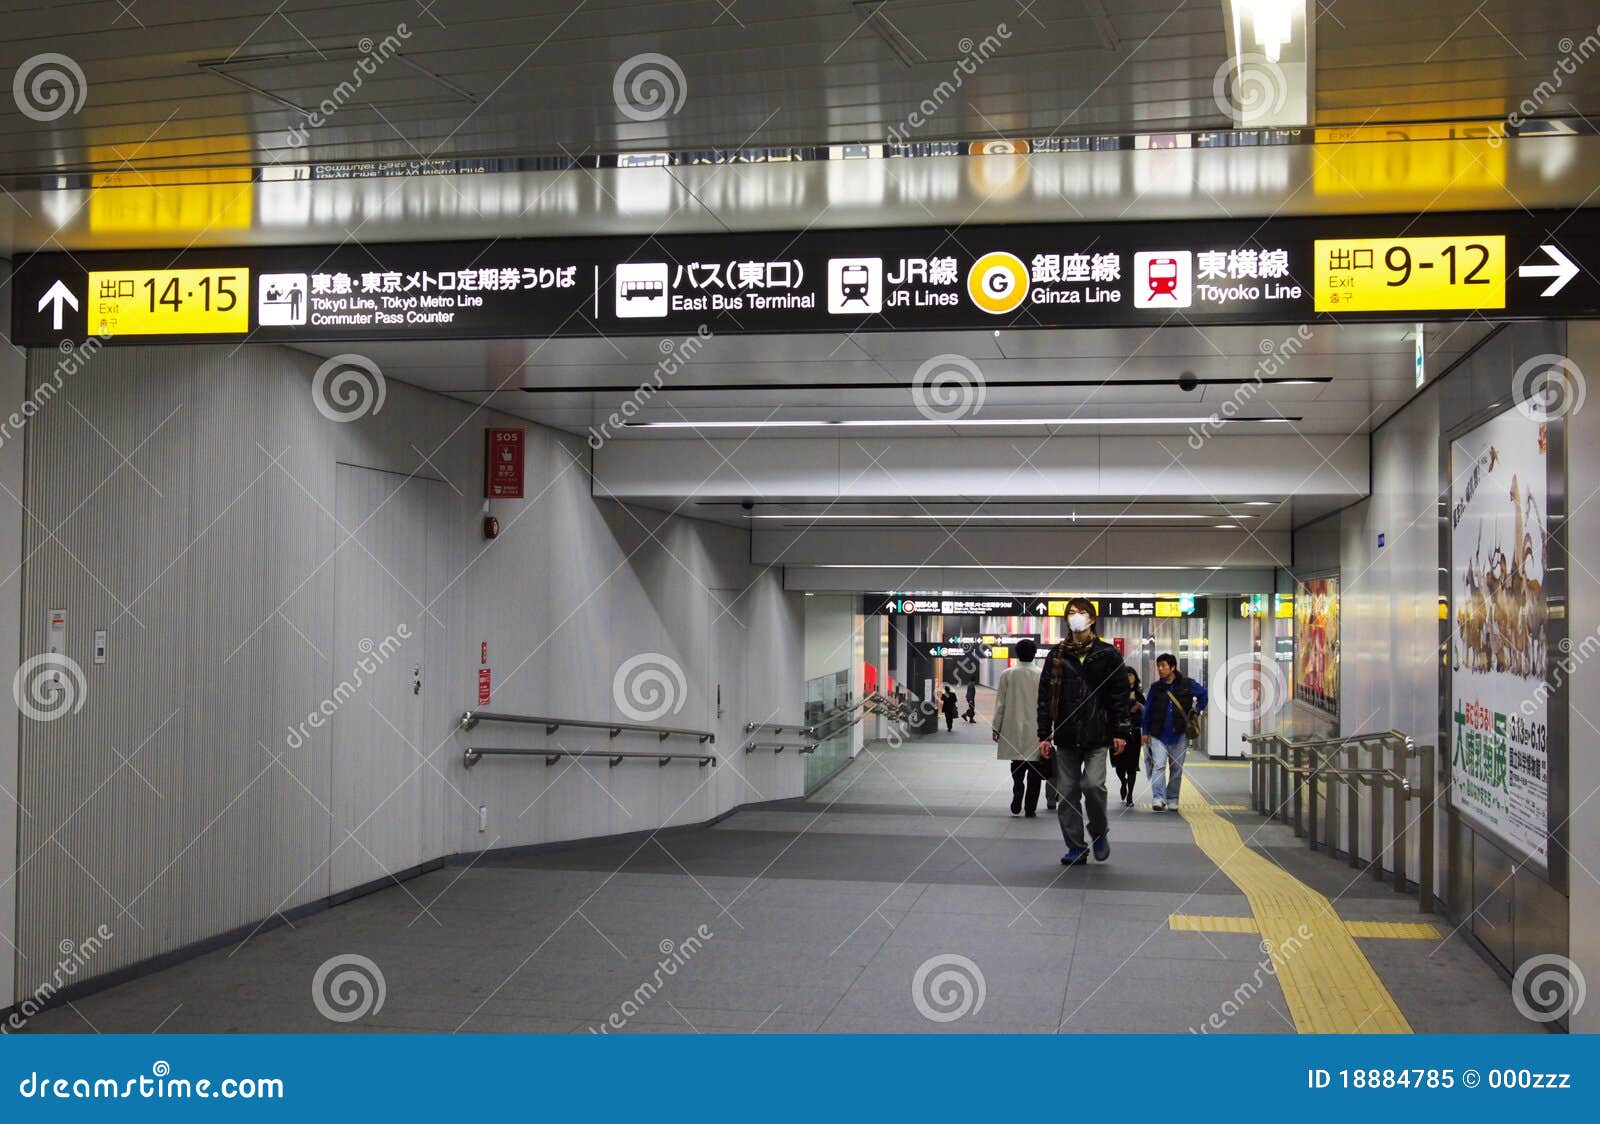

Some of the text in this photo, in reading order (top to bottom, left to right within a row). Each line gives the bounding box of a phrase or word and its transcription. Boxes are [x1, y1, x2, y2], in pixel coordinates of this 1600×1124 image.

[887, 256, 959, 285] JR線
[1031, 252, 1121, 283] 銀座線
[1196, 248, 1290, 280] 東横線
[1329, 244, 1490, 287] 出口 9-12
[100, 279, 135, 298] 出口
[311, 265, 577, 295] 東急・東京メトロ定期券うりば
[988, 273, 1009, 293] G
[1329, 275, 1355, 288] Exit
[887, 290, 959, 306] JR Lines
[1031, 286, 1122, 305] Ginza Line
[1265, 283, 1302, 299] Line
[99, 303, 119, 314] Exit
[350, 297, 378, 311] Line,
[420, 295, 455, 308] Metro
[457, 294, 483, 307] Line
[672, 292, 815, 311] East Bus Terminal
[311, 311, 455, 325] Commuter Pass Counter
[496, 433, 518, 441] SOS
